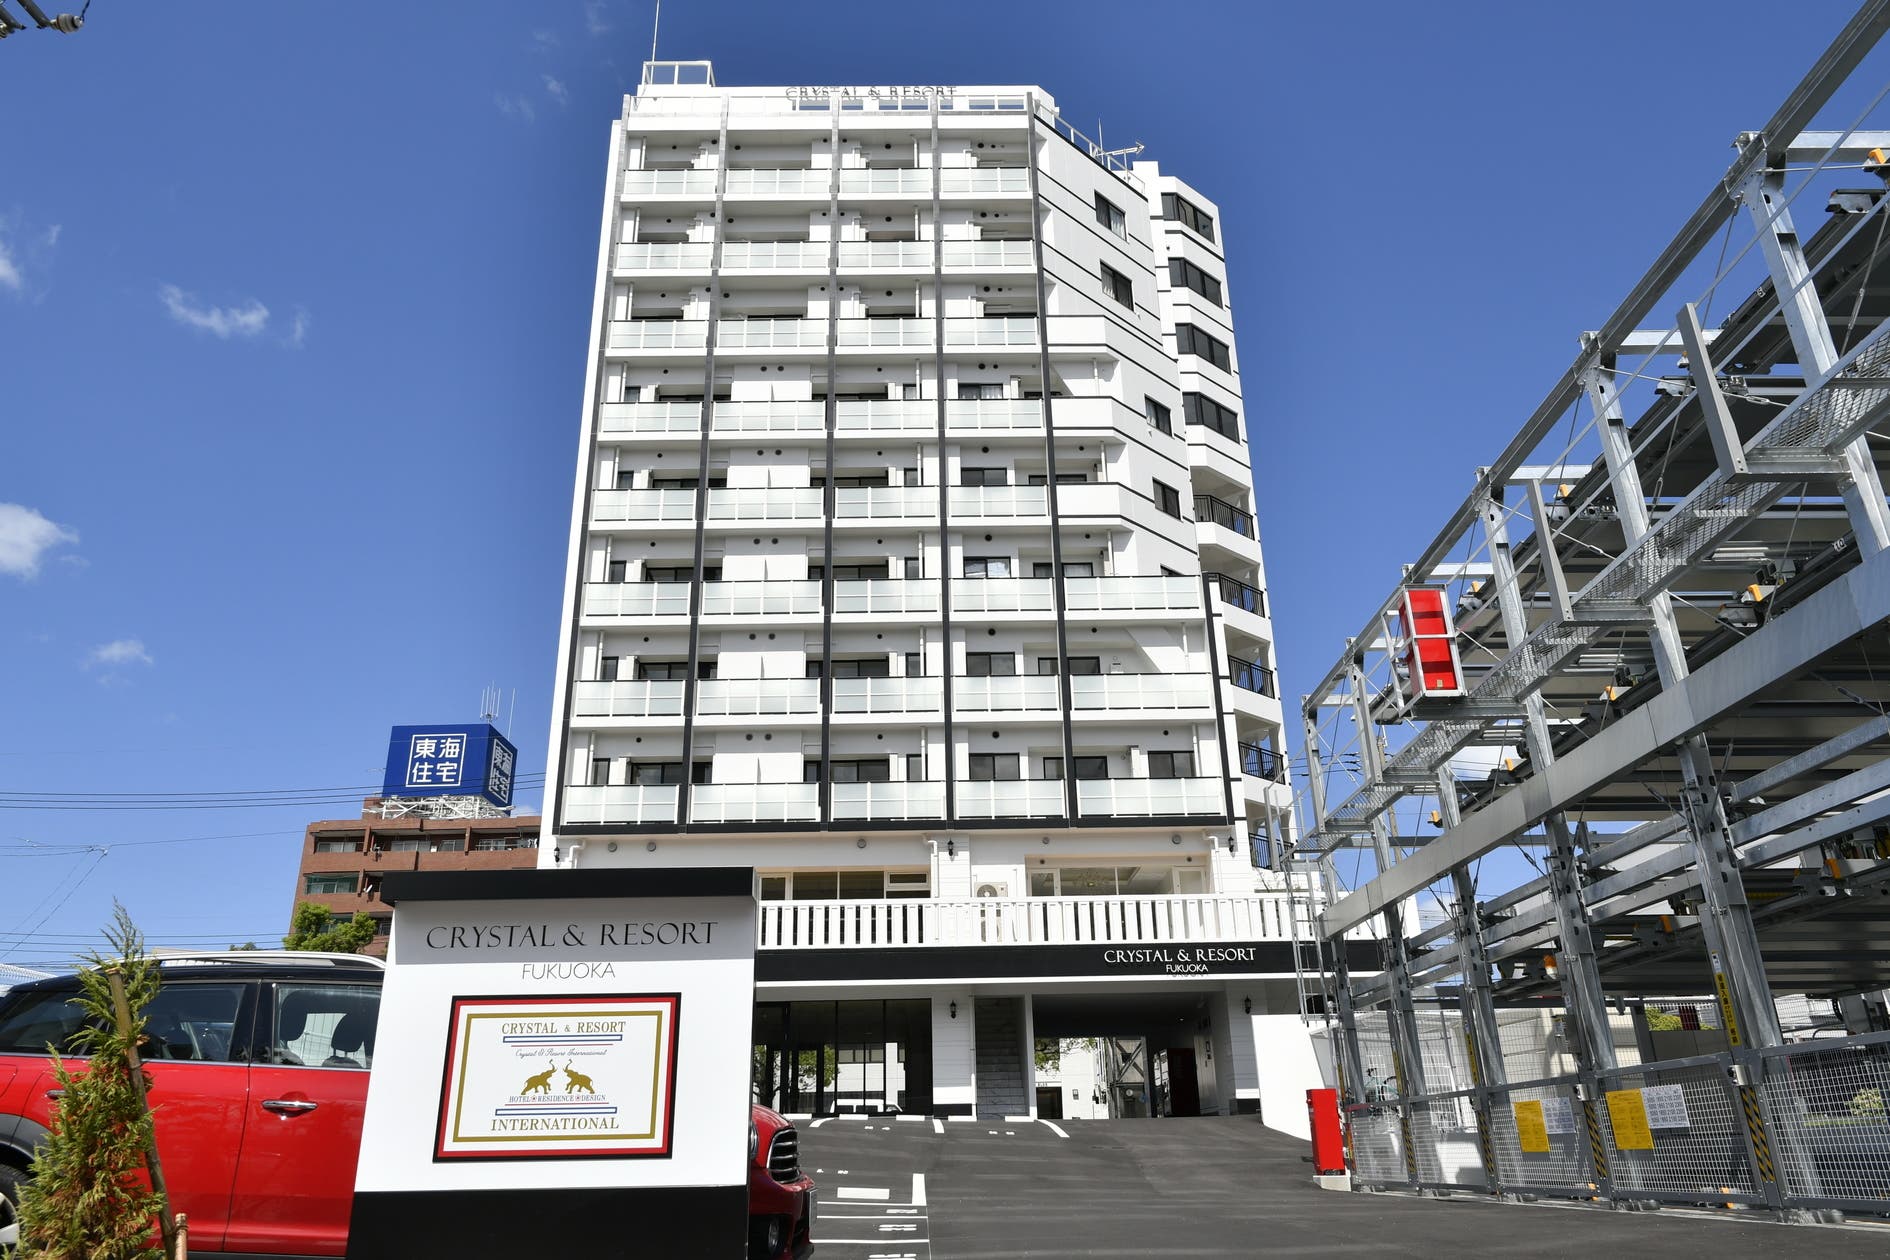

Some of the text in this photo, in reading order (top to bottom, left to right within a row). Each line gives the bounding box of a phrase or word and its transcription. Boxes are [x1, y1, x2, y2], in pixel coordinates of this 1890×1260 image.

[414, 738, 461, 758] 東海
[412, 761, 458, 782] 住宅
[426, 921, 719, 949] CRYSTAL & RESORT
[1104, 947, 1256, 963] CRYSTAL & RESORT
[522, 961, 616, 980] FUKUOKA
[1166, 963, 1208, 973] FUKUOKA
[501, 1020, 626, 1035] CRYSTAL & RESORT
[508, 1094, 606, 1104] HOTEL RESIDENCE DESIGN
[491, 1117, 619, 1131] INTERNATIONAL
